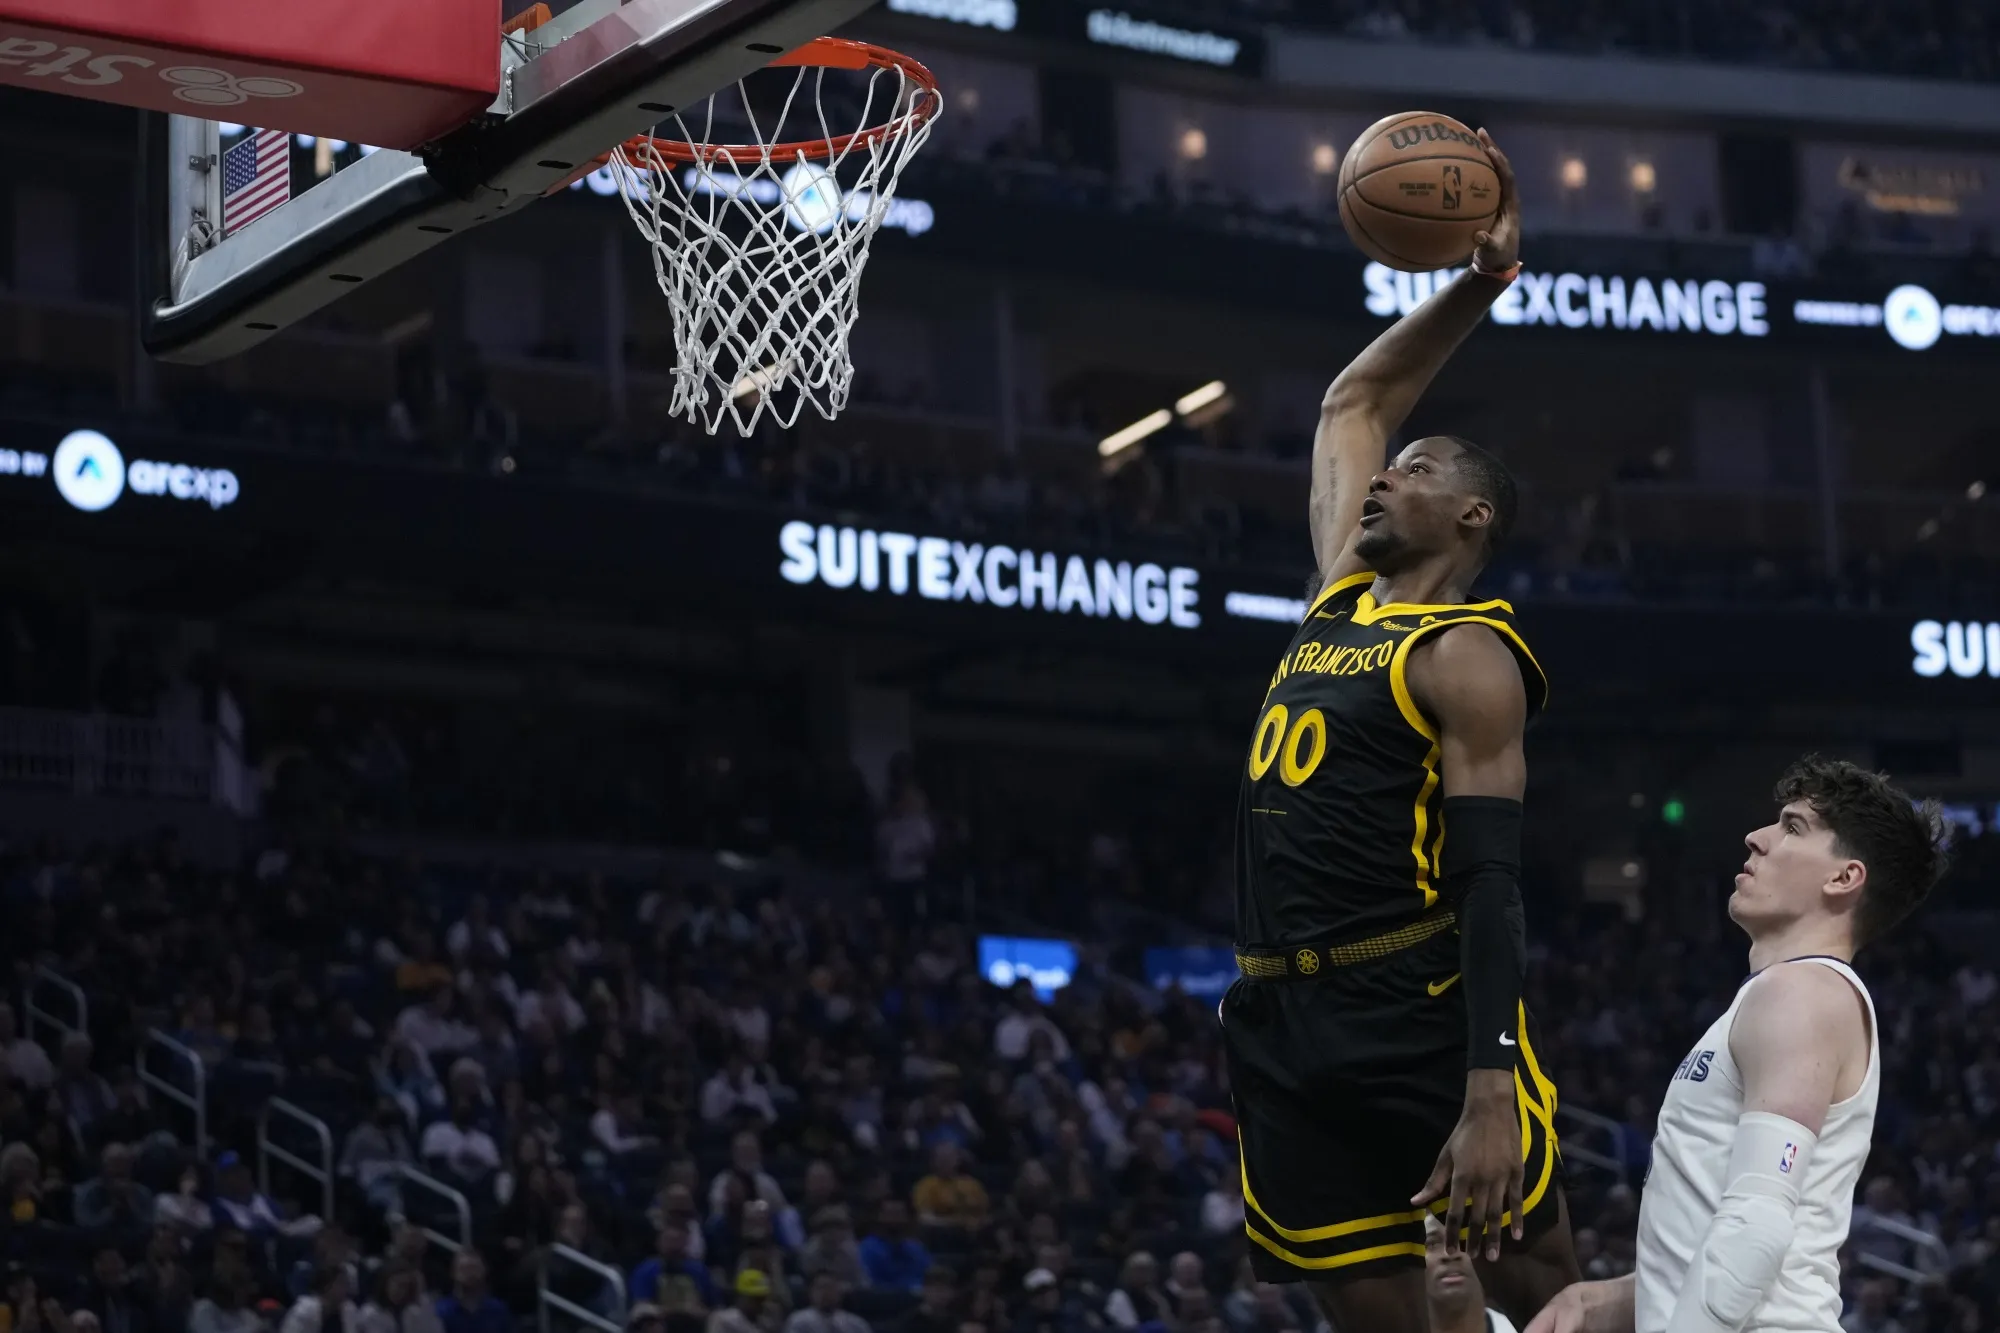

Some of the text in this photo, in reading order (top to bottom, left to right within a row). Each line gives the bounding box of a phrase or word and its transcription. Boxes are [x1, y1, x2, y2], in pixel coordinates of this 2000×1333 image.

[779, 520, 1201, 628] SUITEXCHANGE
[1291, 640, 1394, 676] FRANCISCO
[1911, 619, 2000, 678] SUI
[1248, 703, 1327, 787] 00
